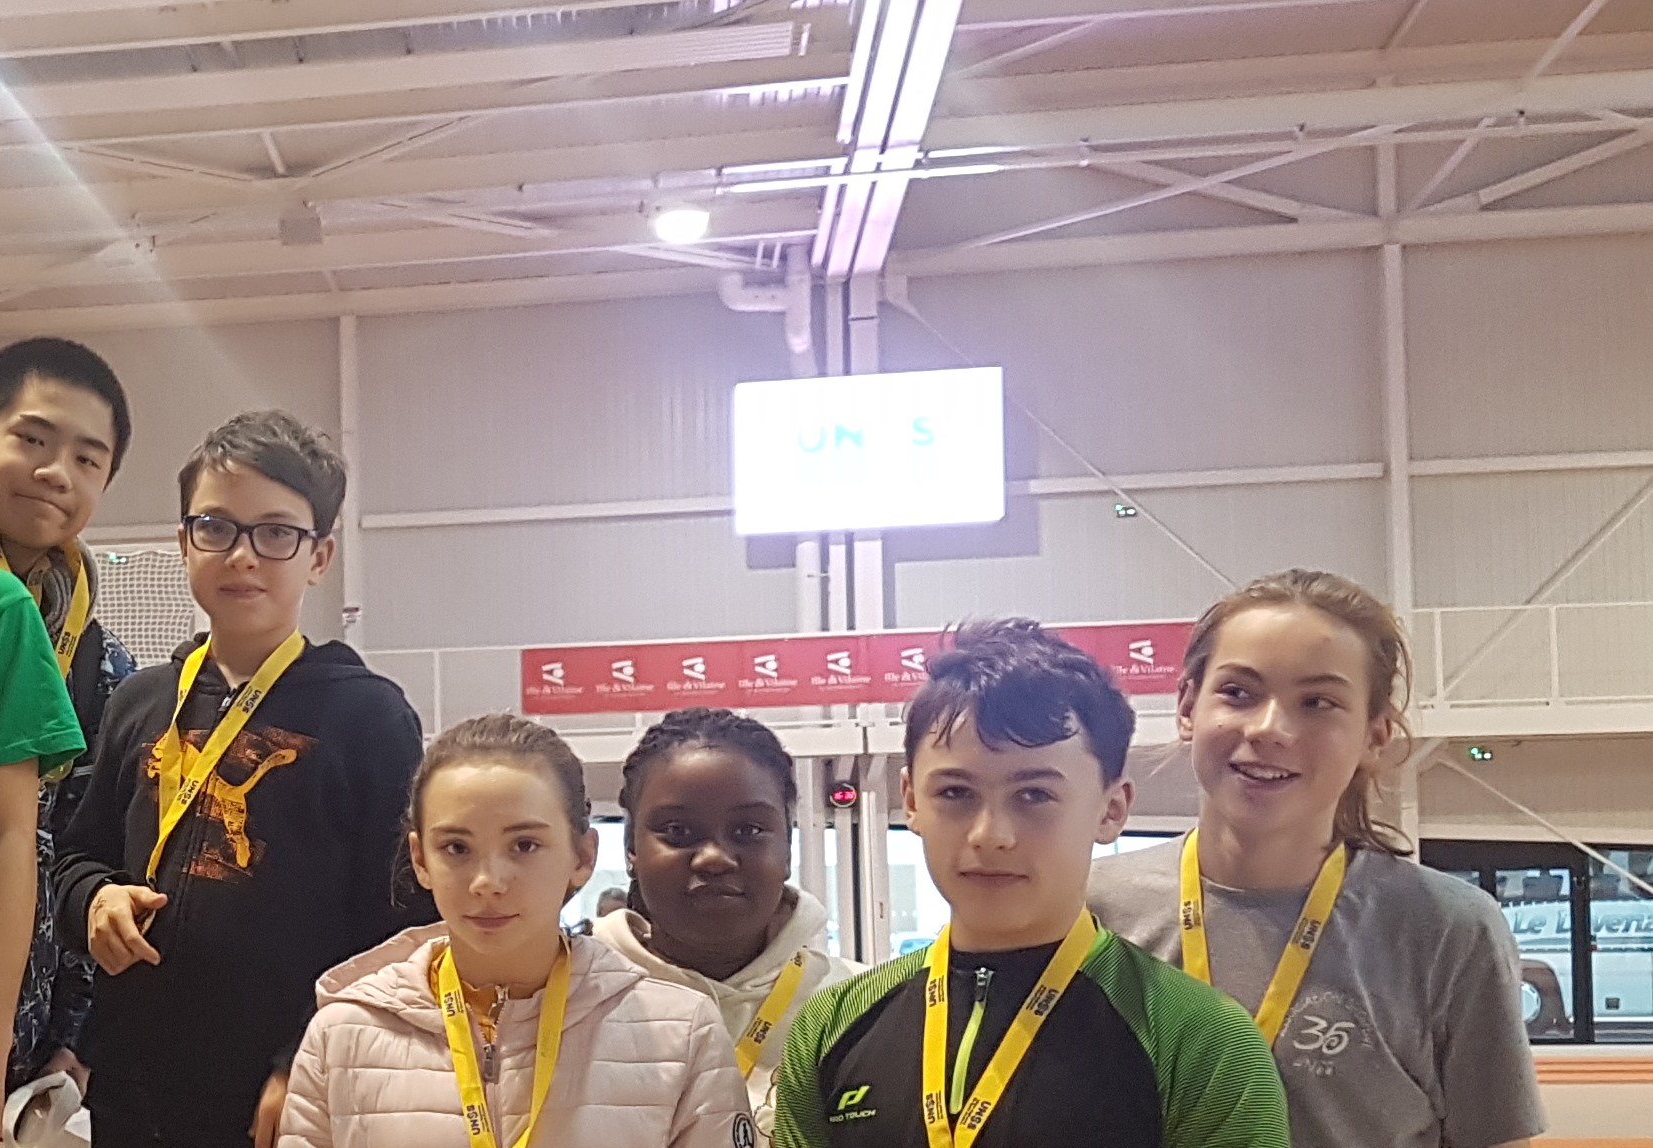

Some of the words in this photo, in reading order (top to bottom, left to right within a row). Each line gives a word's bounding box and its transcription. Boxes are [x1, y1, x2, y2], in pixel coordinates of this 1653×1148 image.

[796, 415, 936, 453] UNS
[1513, 912, 1547, 934] Le
[1293, 1015, 1356, 1055] 35
